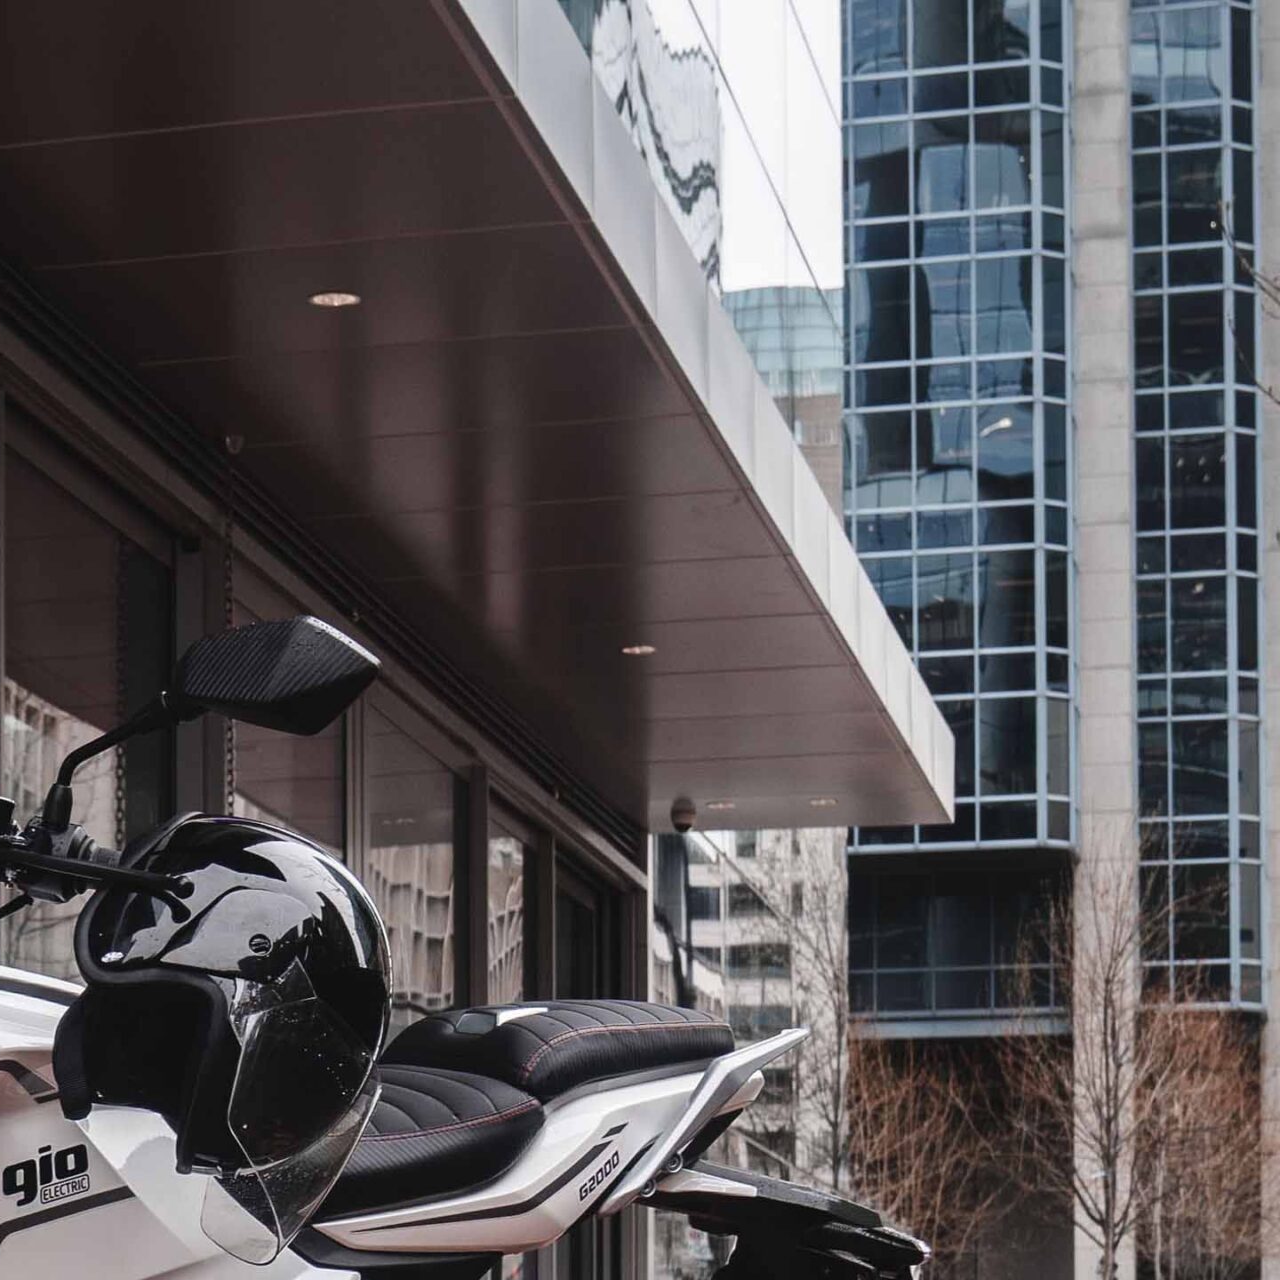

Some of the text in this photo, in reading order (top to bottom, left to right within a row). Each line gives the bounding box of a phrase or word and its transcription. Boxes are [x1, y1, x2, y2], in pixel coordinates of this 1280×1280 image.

[2, 1144, 89, 1207] gio
[43, 1177, 87, 1201] ELECTRIC
[579, 1150, 620, 1201] G2000
